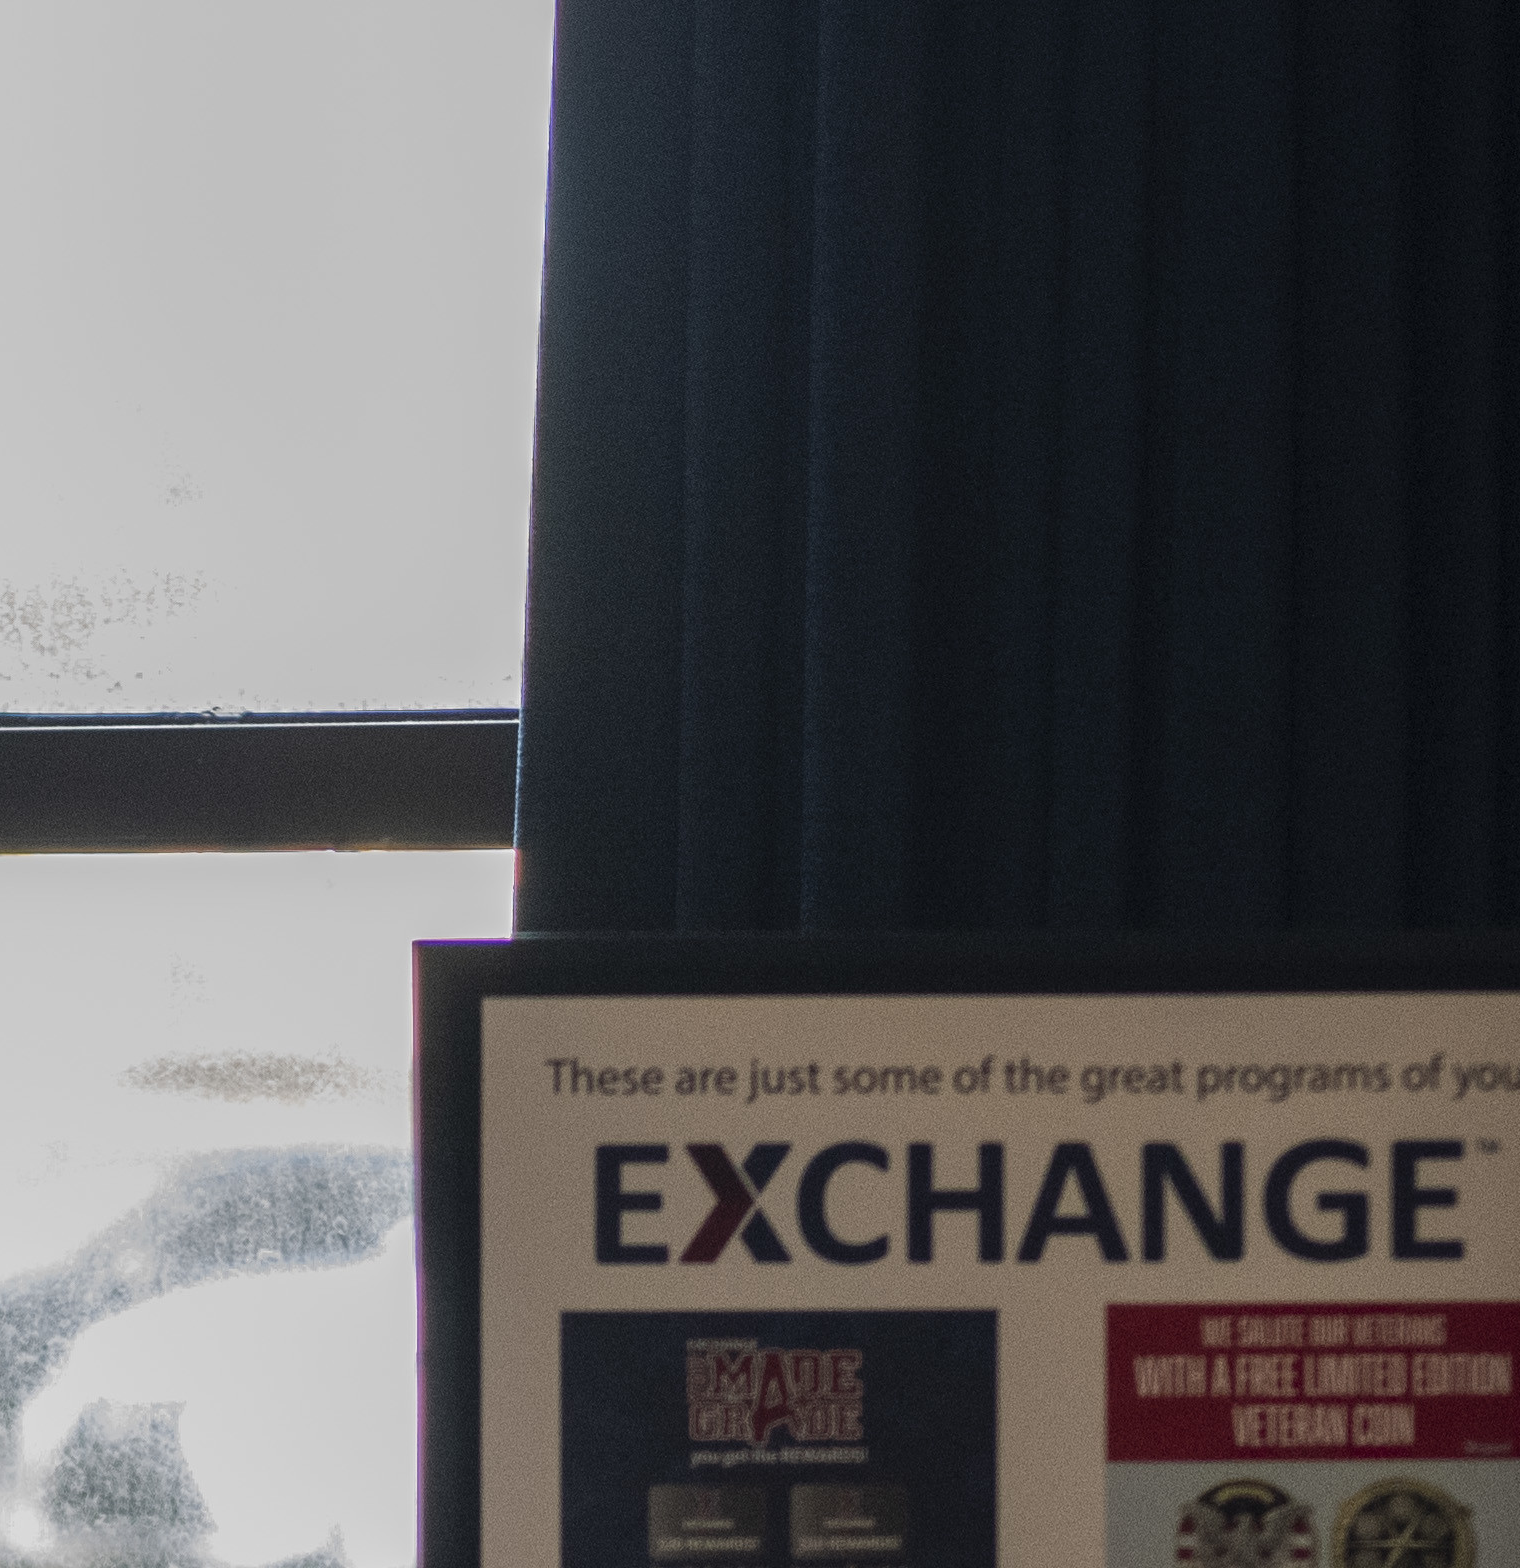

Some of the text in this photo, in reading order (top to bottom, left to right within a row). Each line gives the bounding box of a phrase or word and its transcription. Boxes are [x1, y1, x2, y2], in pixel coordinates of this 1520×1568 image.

[545, 1058, 664, 1097] These
[674, 1065, 738, 1097] are
[744, 1058, 821, 1105] just
[832, 1065, 942, 1097] some
[952, 1054, 995, 1097] of
[1004, 1058, 1071, 1097] the
[1079, 1060, 1185, 1104] great
[1196, 1063, 1392, 1103] programs
[1401, 1053, 1445, 1095] of
[1234, 1354, 1300, 1397] FREE
